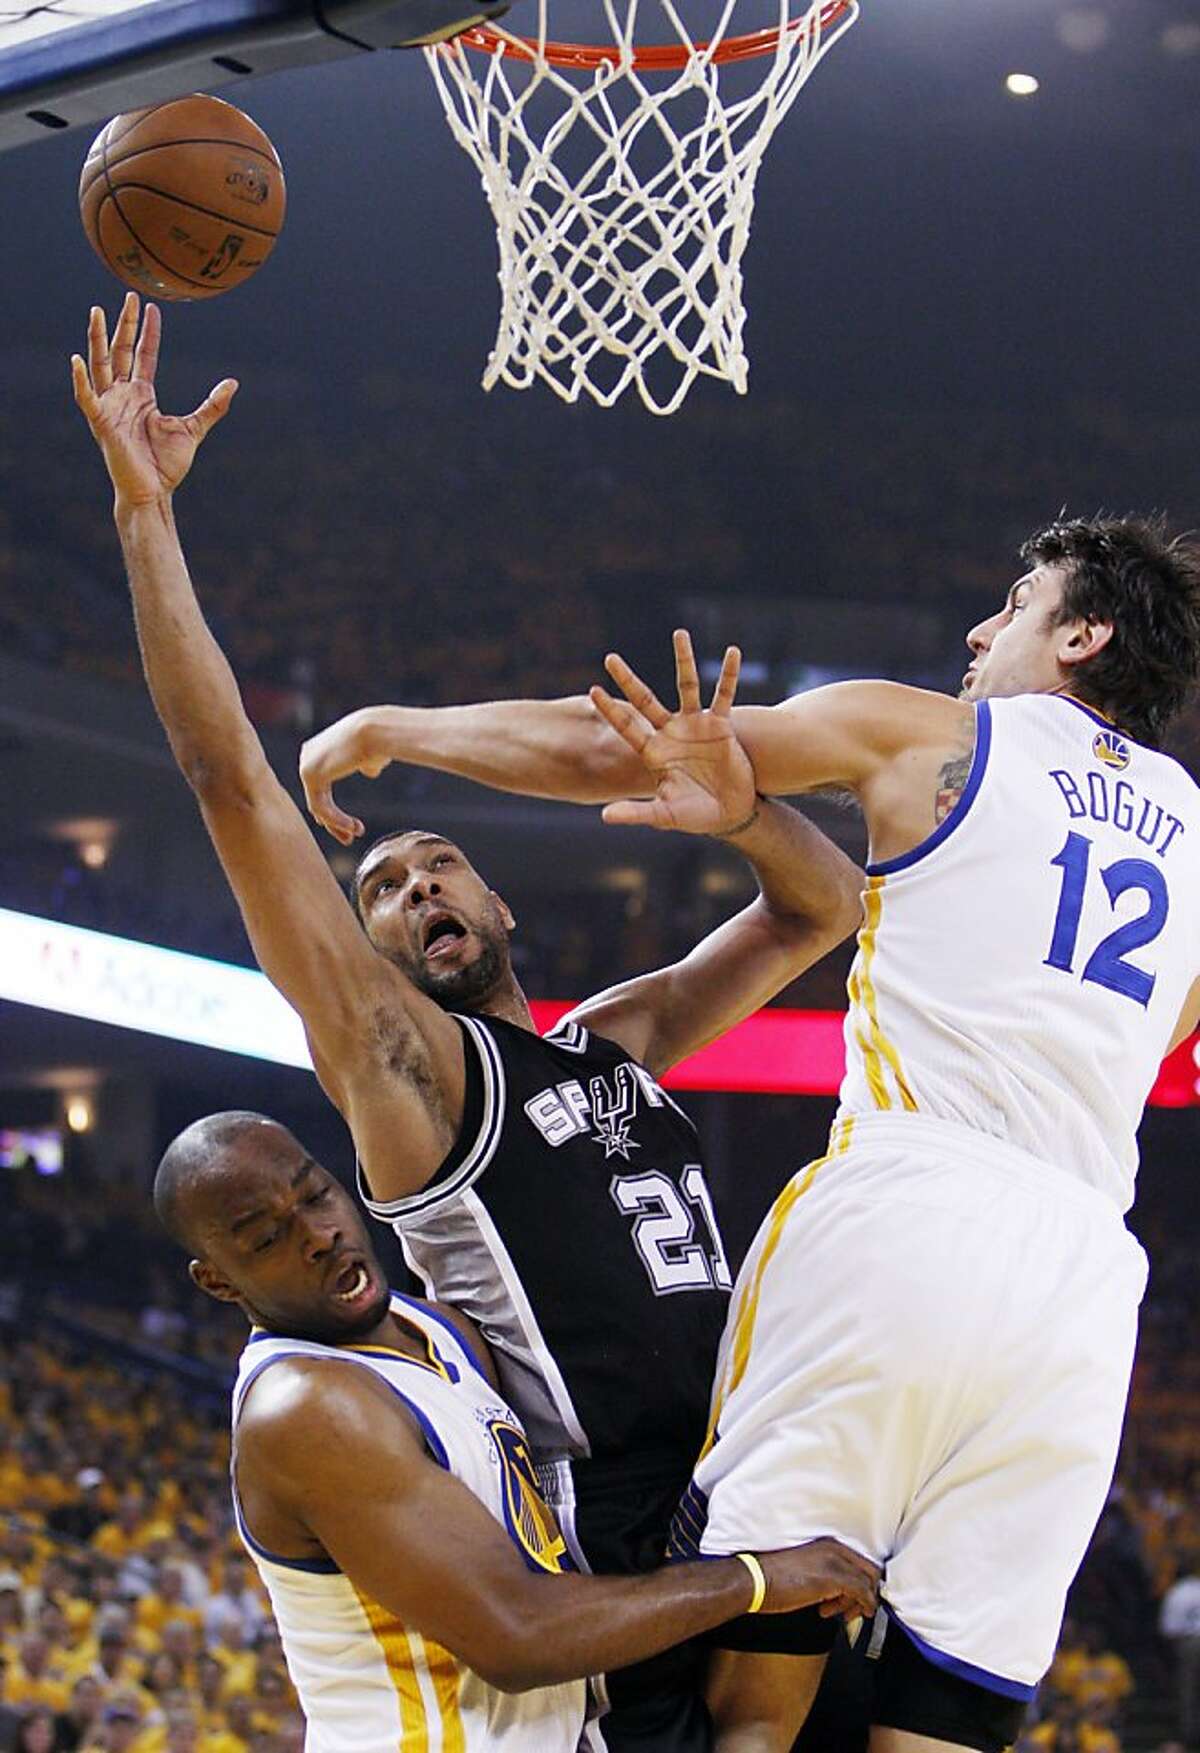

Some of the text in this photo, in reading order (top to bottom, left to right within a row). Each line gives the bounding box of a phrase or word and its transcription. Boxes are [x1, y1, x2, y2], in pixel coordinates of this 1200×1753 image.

[1048, 769, 1185, 858] BOGUT
[1042, 830, 1170, 1010] 12
[609, 1164, 734, 1297] 21
